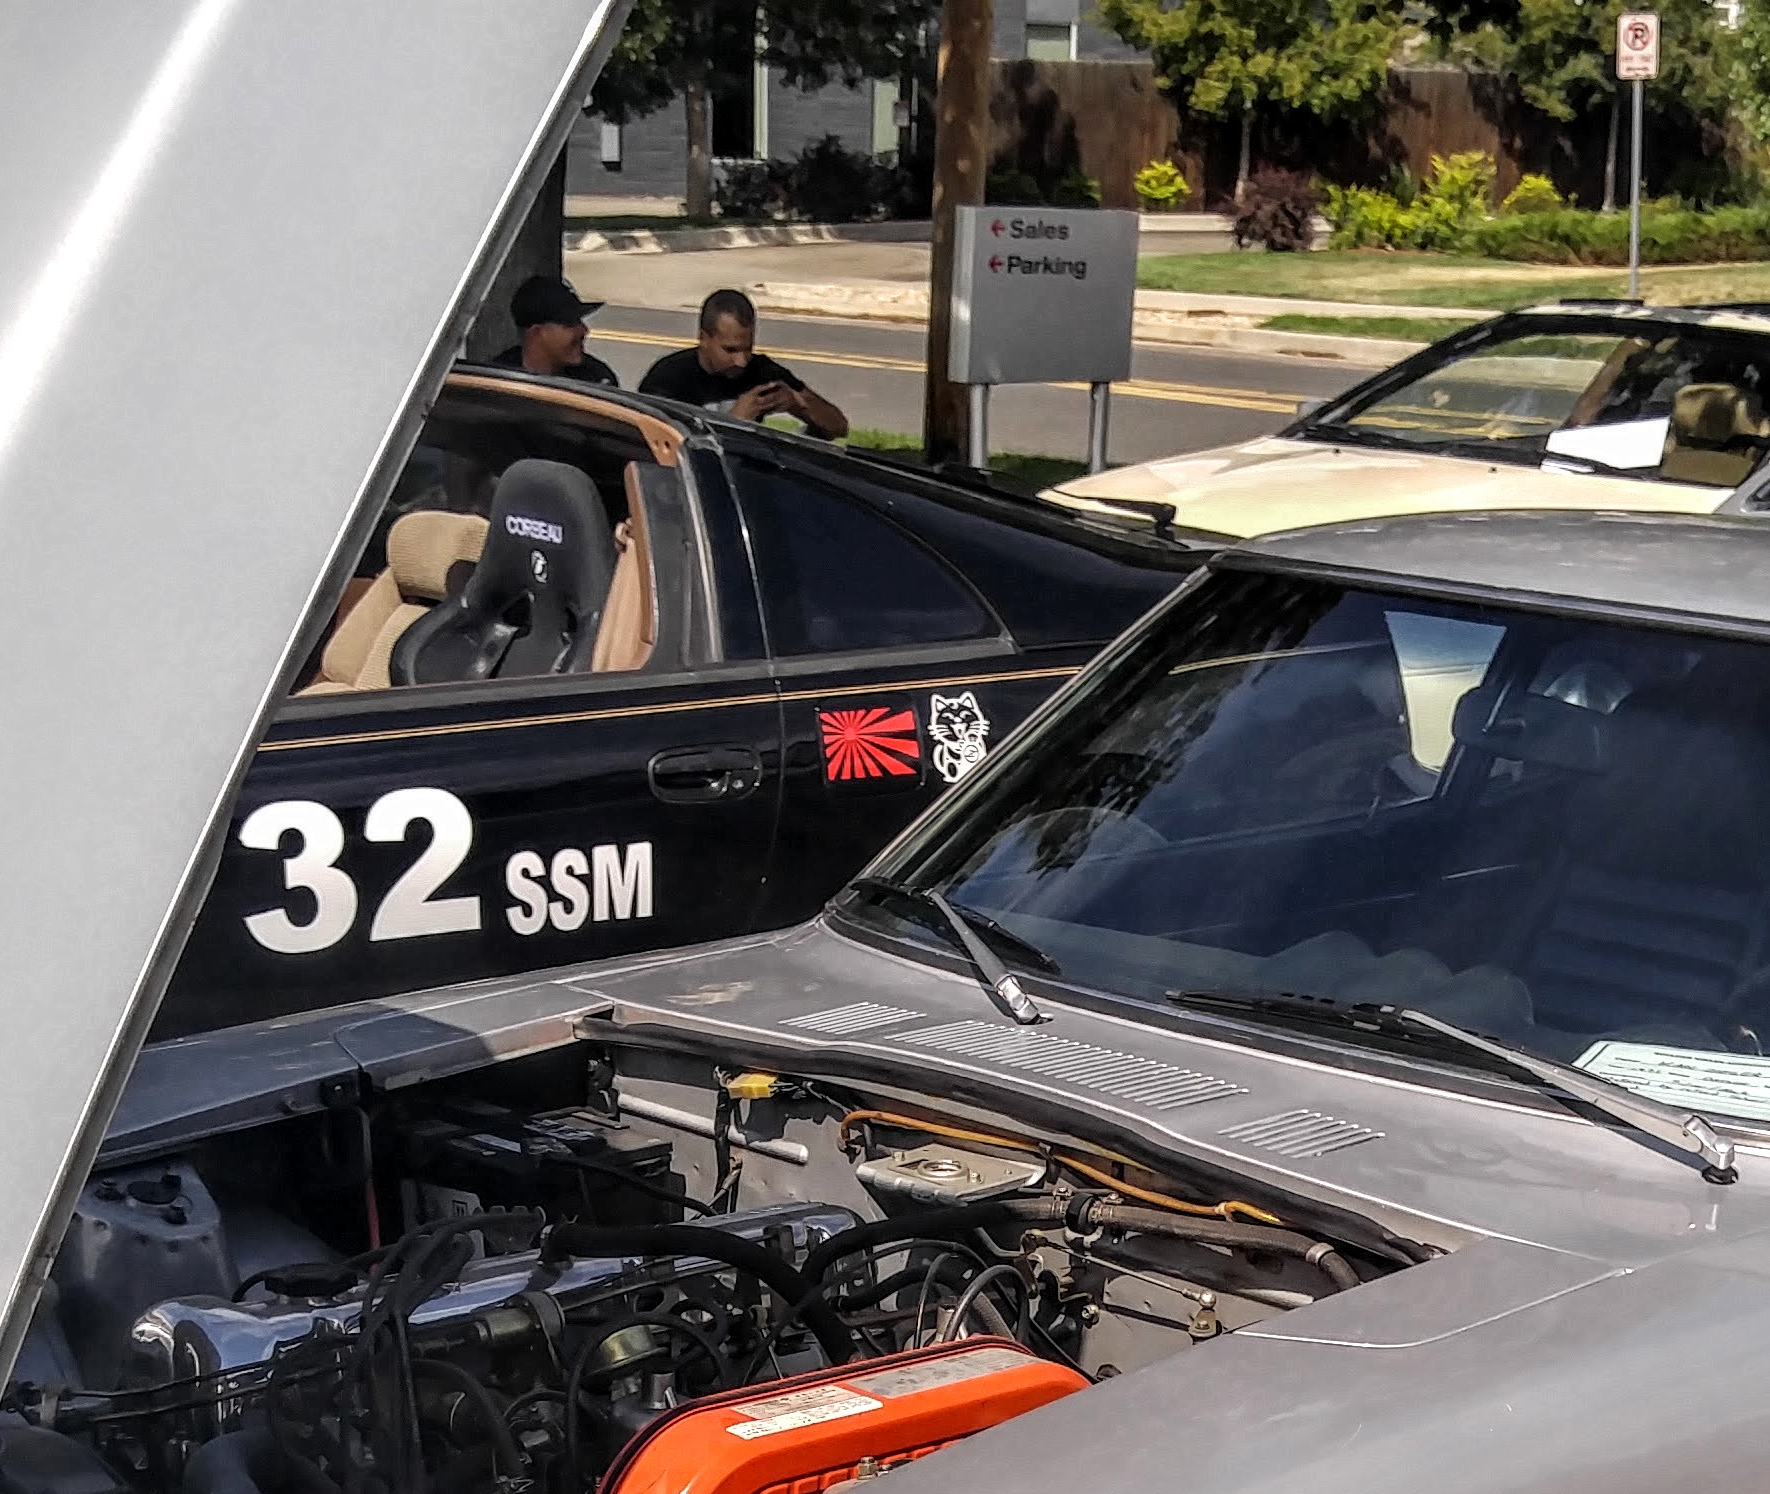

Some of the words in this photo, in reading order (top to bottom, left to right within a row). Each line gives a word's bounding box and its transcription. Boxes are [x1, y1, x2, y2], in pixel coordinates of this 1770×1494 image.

[1009, 218, 1071, 240] Sales
[1006, 255, 1088, 280] Parking
[239, 786, 482, 955] 32
[504, 841, 654, 936] SSM
